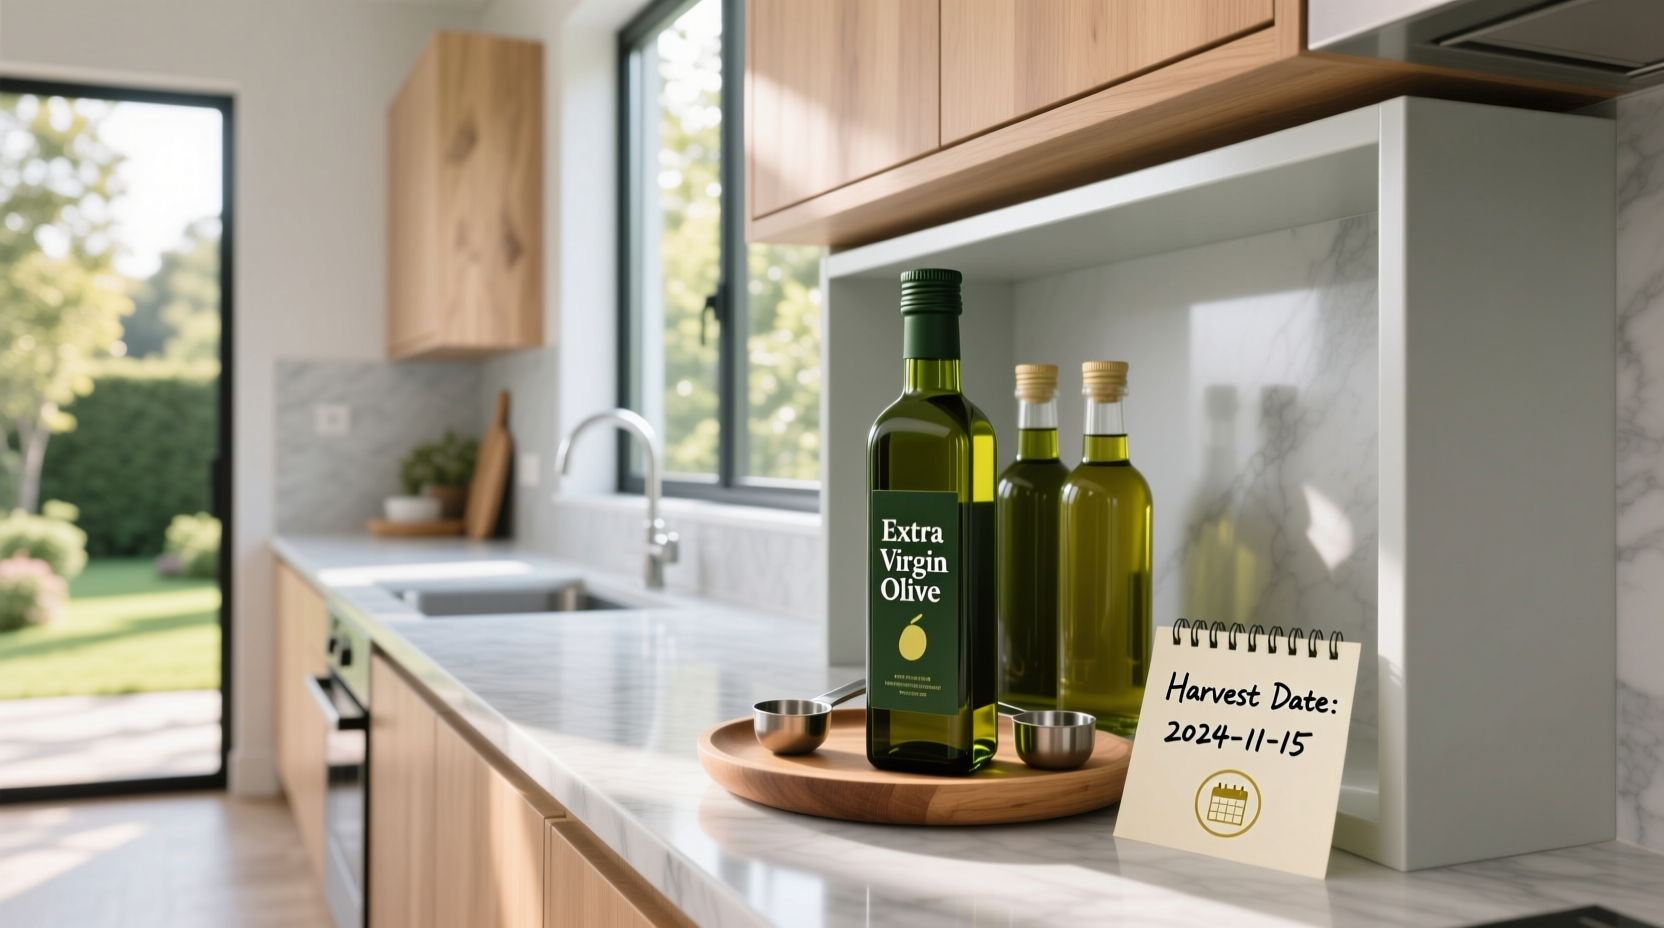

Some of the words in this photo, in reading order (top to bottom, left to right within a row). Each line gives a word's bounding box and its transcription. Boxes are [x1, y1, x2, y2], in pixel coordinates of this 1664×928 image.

[881, 518, 944, 543] Extra
[880, 548, 949, 580] Virgin
[880, 577, 941, 603] Olive
[1165, 671, 1261, 708] Harvest
[1270, 681, 1339, 715] Date:
[1163, 720, 1314, 757] 2024-11-15
